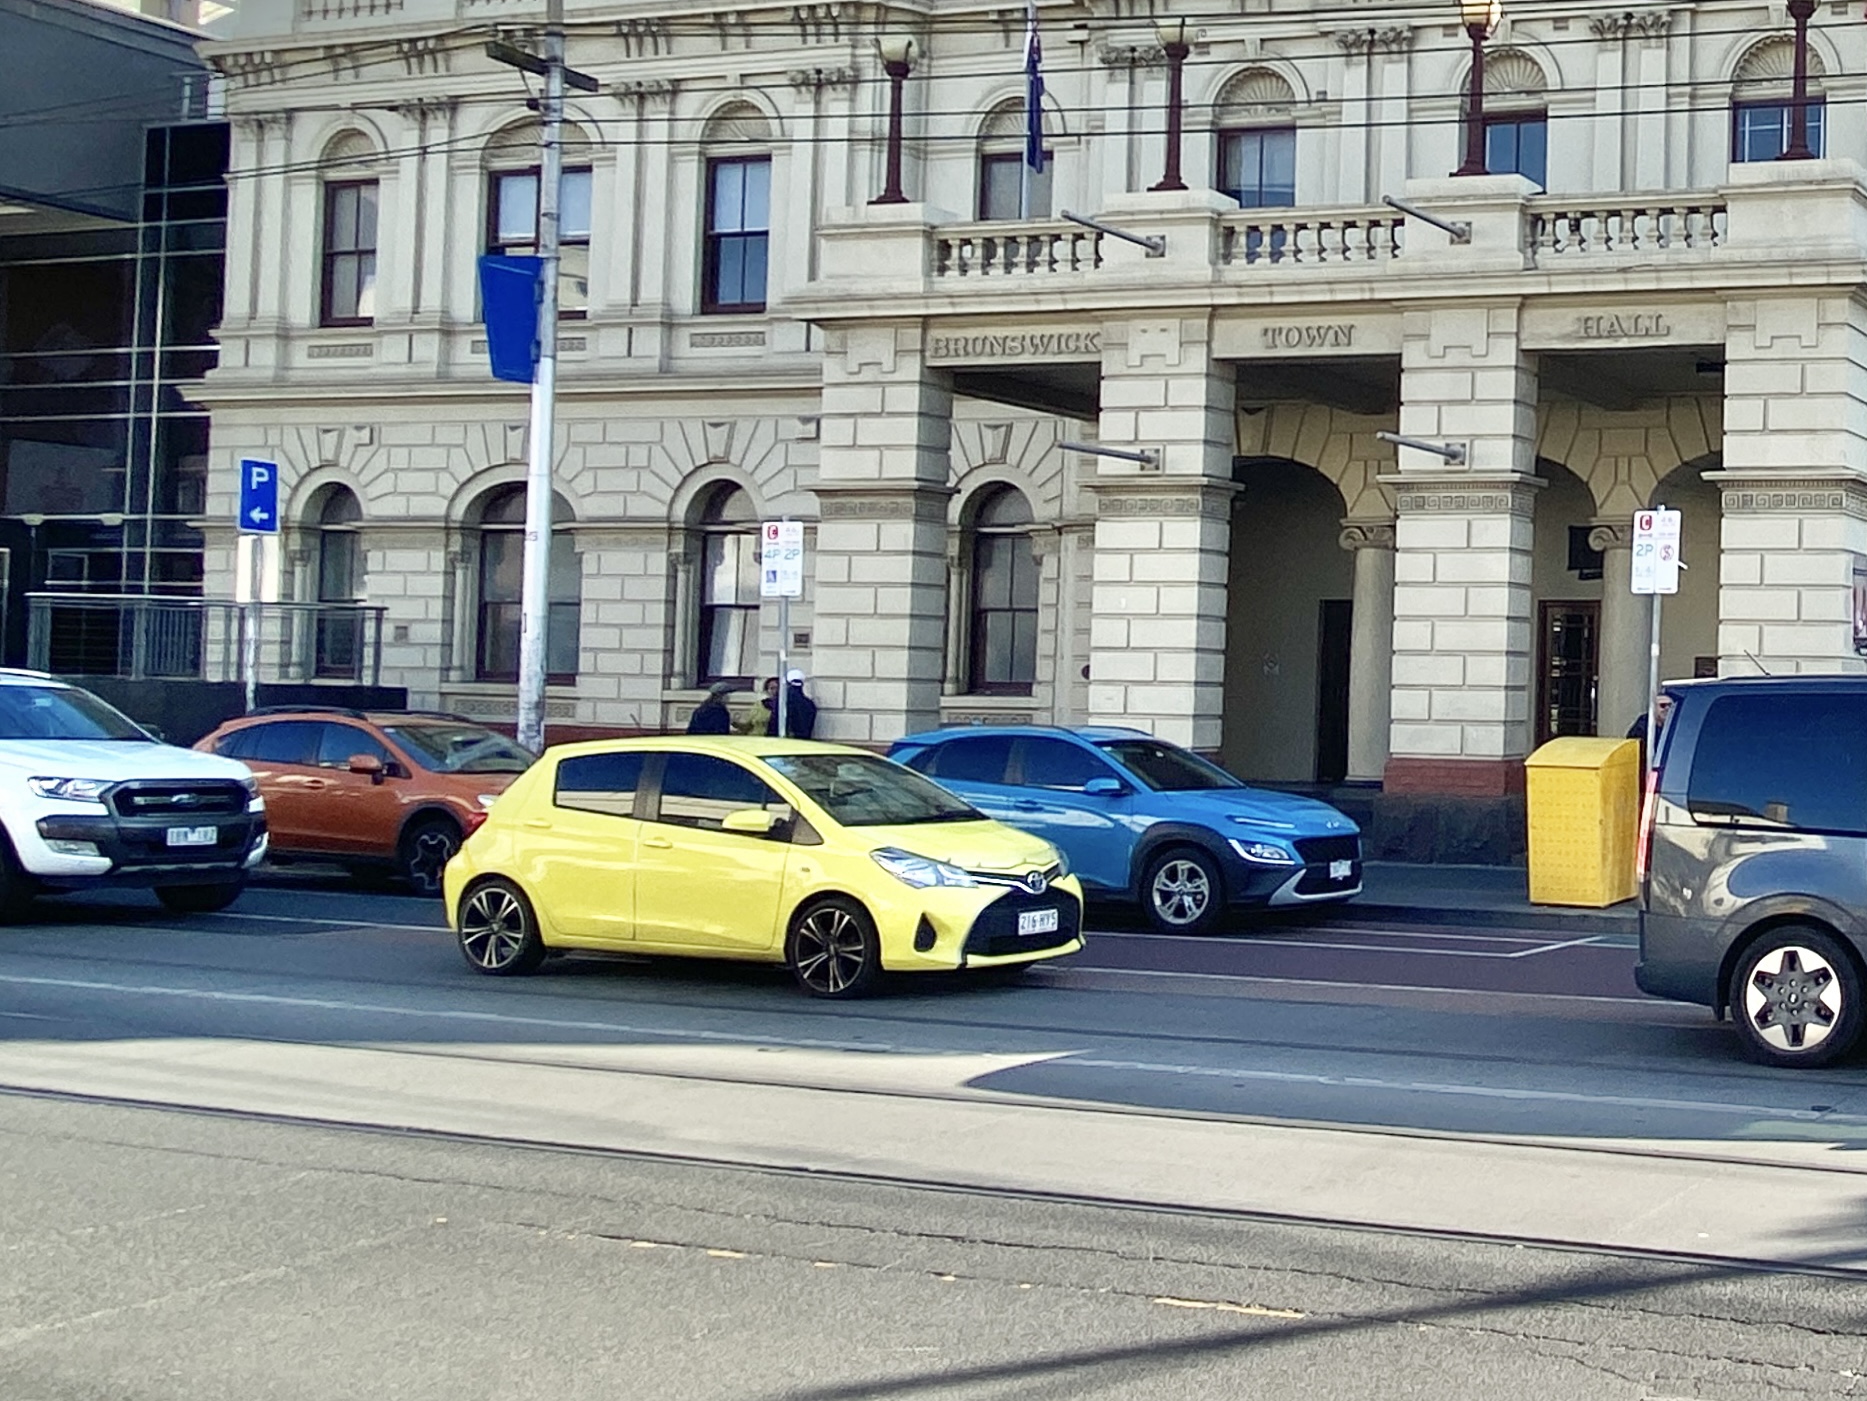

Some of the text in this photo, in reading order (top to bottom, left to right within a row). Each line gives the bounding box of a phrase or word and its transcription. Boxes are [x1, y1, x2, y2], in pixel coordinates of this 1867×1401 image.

[930, 313, 1671, 359] BRUNSWICK TOWN HALL
[251, 466, 270, 490] P
[764, 548, 781, 559] 4P
[784, 548, 800, 560] 2P
[1635, 543, 1654, 557] 2P
